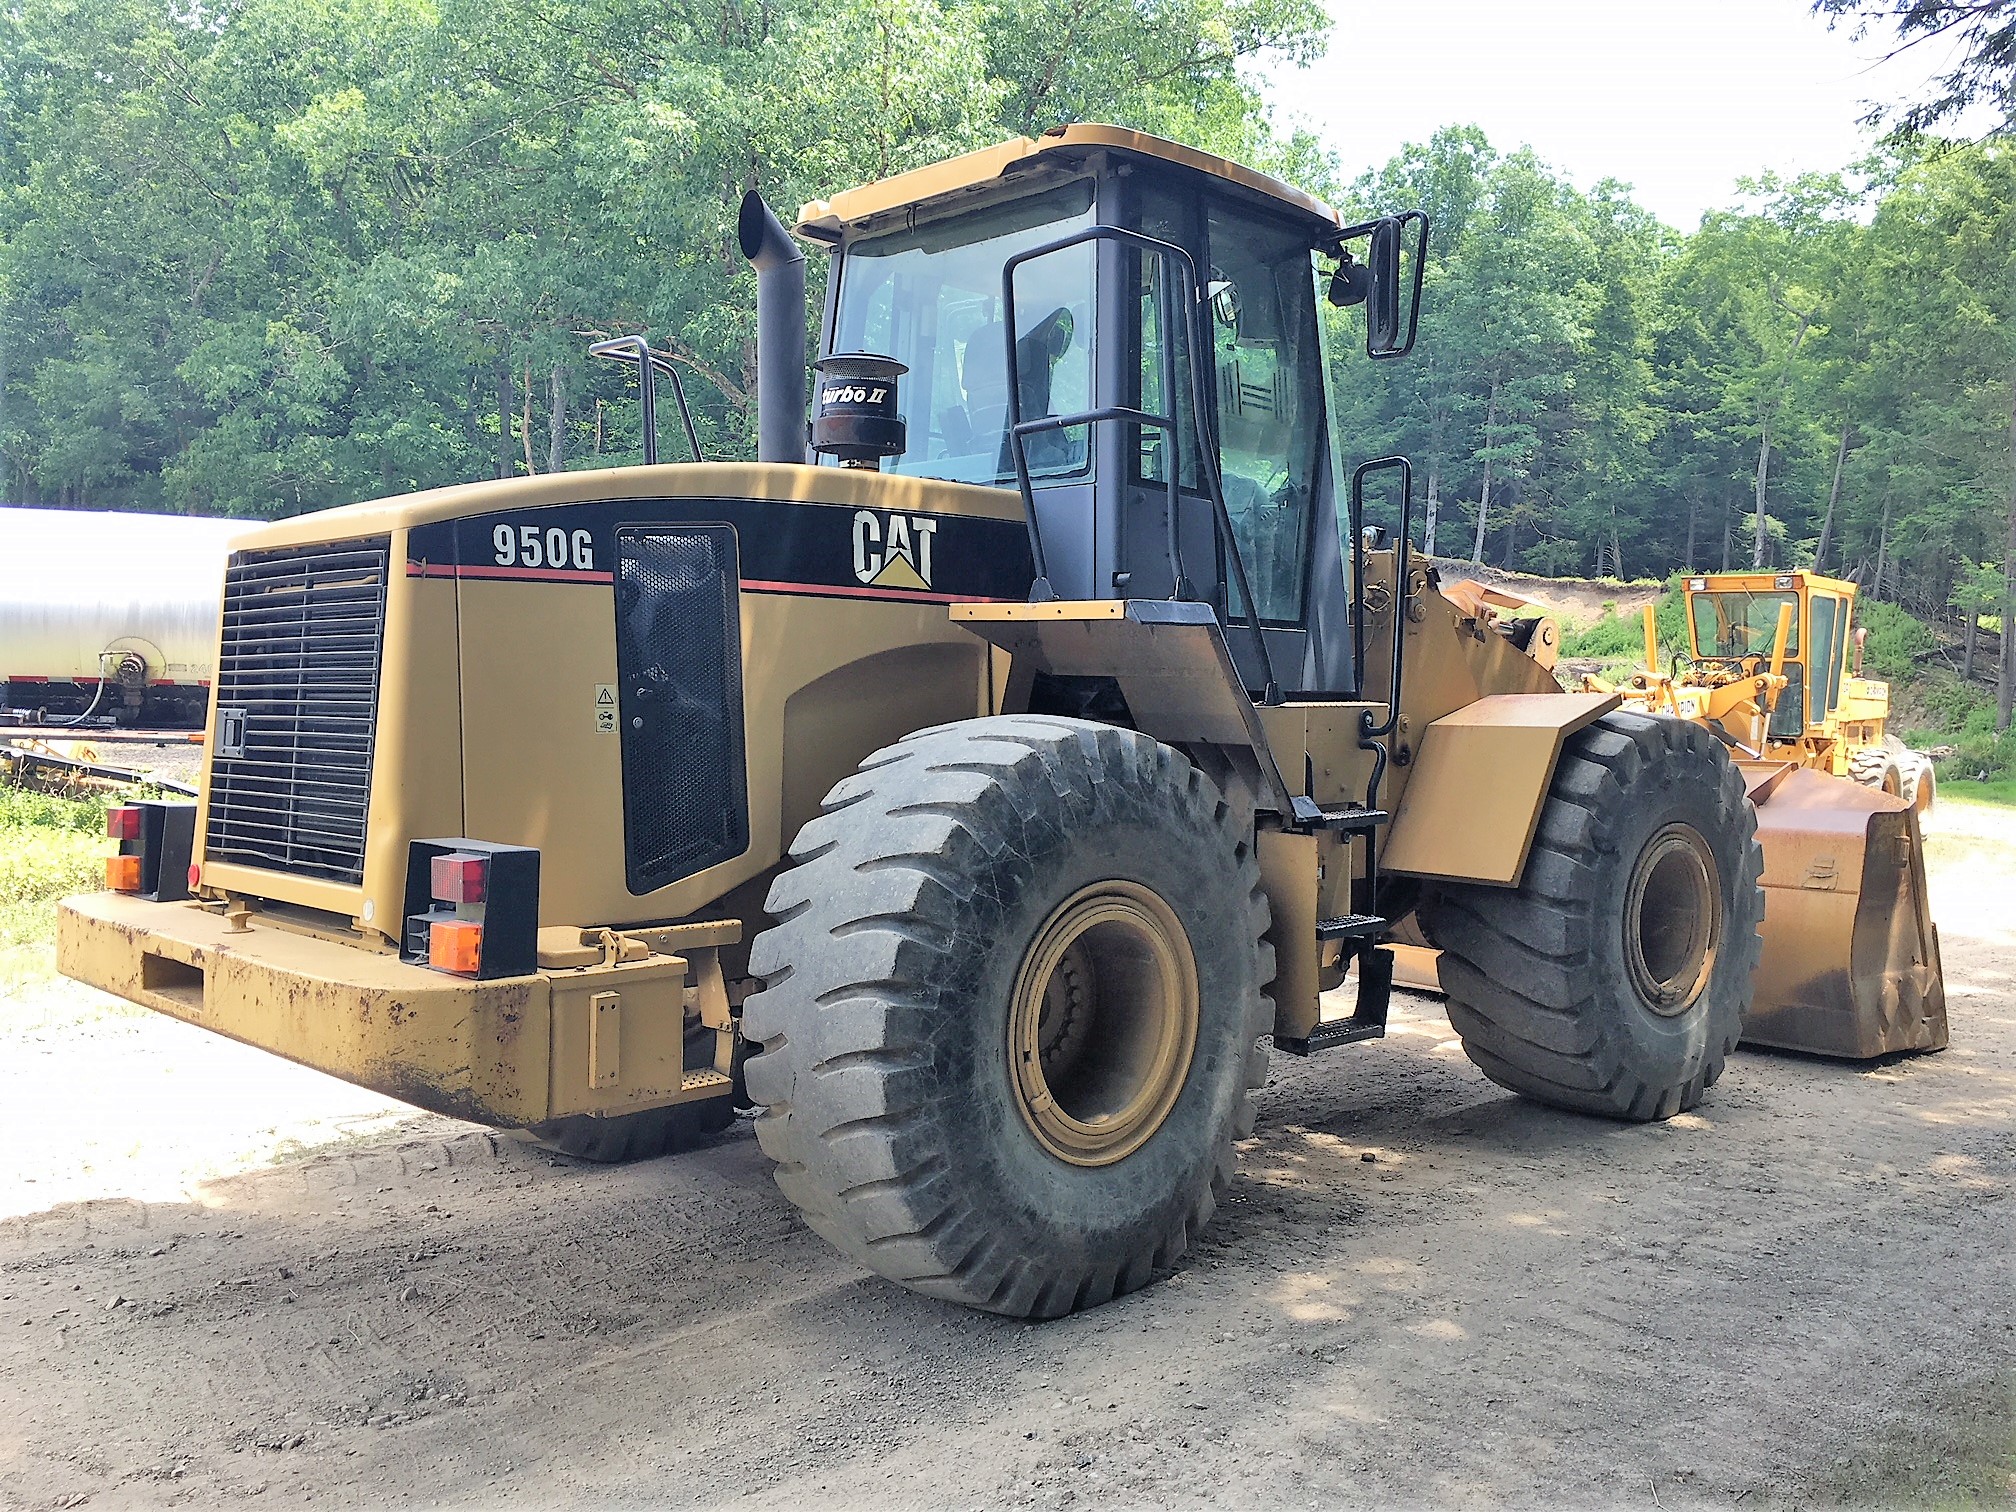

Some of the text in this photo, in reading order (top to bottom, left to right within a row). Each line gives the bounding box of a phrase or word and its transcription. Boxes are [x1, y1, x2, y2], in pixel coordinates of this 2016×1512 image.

[866, 387, 888, 404] II
[492, 523, 595, 571] 950G
[852, 510, 938, 589] CAT
